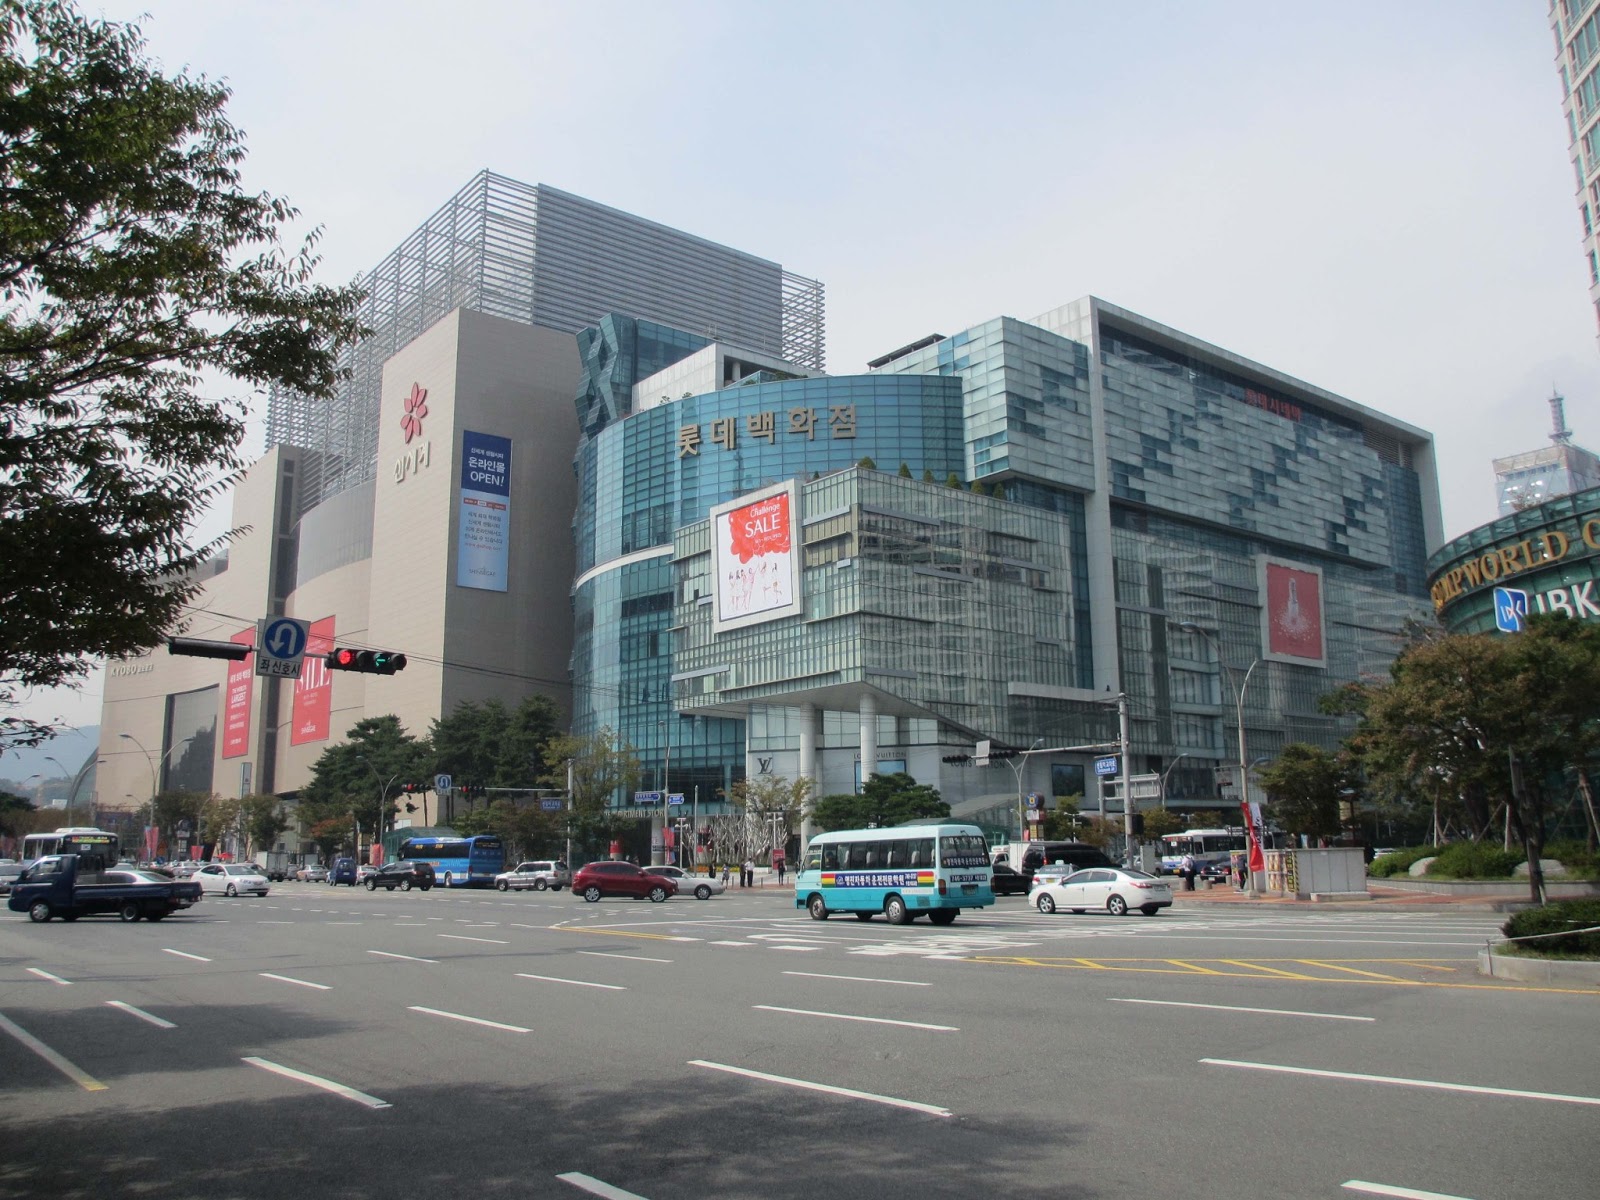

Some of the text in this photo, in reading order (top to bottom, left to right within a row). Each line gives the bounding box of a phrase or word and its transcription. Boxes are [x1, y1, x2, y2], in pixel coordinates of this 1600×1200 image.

[678, 403, 857, 458] 롯데백화점
[394, 440, 431, 484] 신세계
[468, 456, 505, 473] 온라인몰
[470, 471, 505, 487] OPEN!
[750, 503, 780, 518] Challenge
[745, 512, 781, 538] SALE
[260, 658, 301, 678] 좌 신호시
